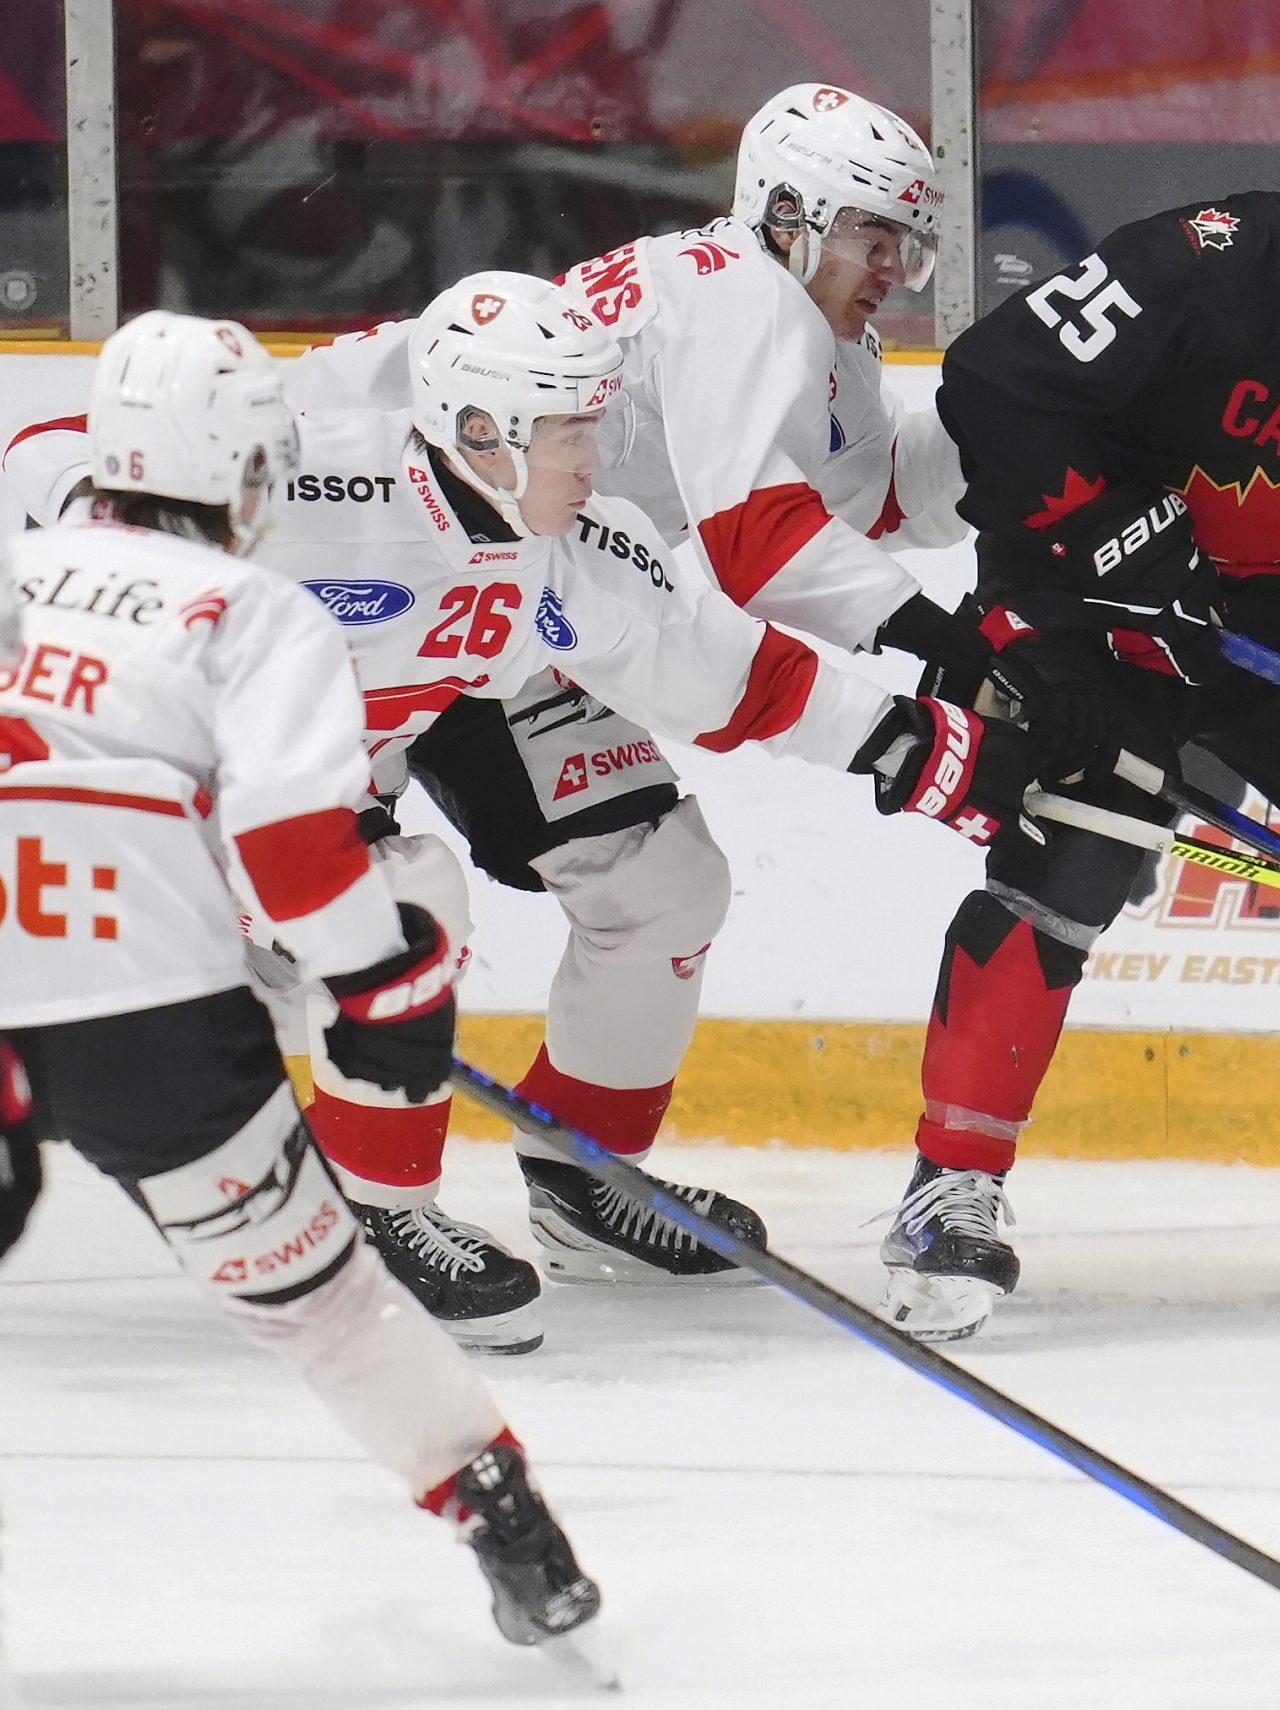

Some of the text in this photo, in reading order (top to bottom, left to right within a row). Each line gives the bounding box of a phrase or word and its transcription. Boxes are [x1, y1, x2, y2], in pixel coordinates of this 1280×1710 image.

[562, 308, 593, 332] 26
[1025, 253, 1143, 363] 25
[129, 450, 145, 481] 6
[287, 474, 396, 503] ISSOT
[417, 485, 451, 532] SWISS
[484, 551, 519, 562] SWISS
[319, 585, 389, 617] Ford
[416, 581, 523, 659] 26
[992, 668, 1024, 701] BAUER
[590, 740, 662, 777] SWISS
[253, 1198, 339, 1275] SWISS
